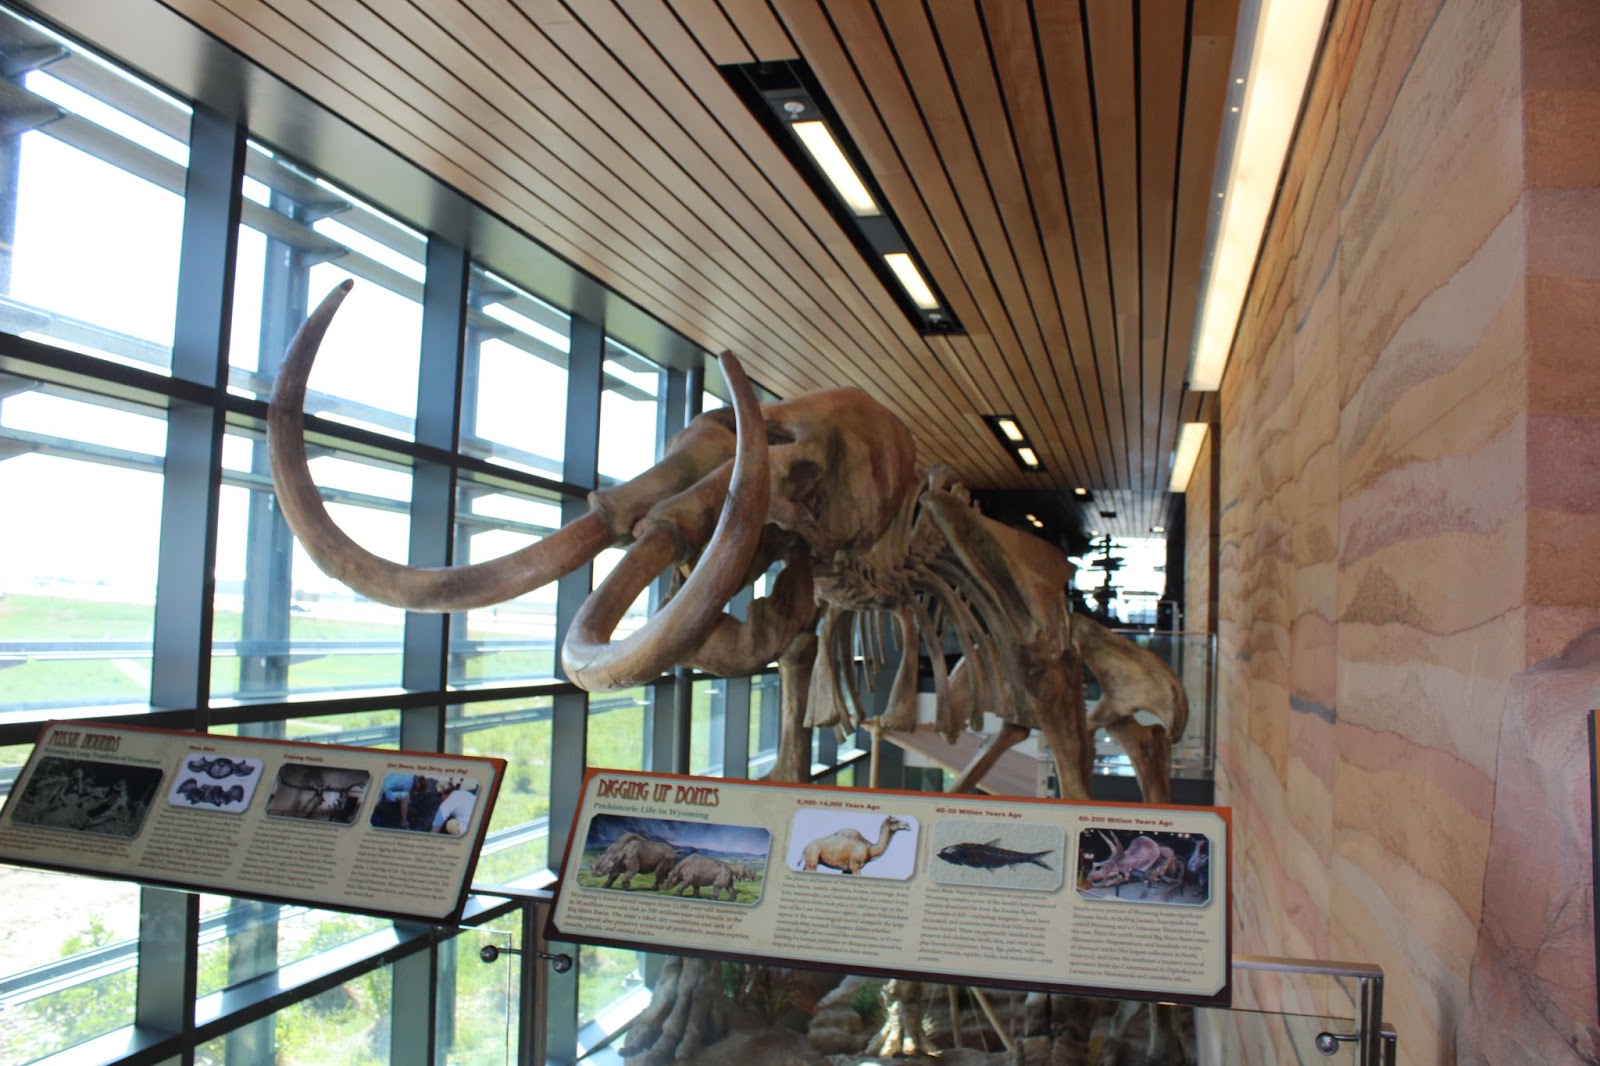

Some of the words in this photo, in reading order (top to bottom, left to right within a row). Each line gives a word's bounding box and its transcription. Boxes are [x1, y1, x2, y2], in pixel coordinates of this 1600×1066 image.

[596, 779, 649, 801] DIGGING
[653, 783, 673, 803] UP
[674, 785, 720, 807] BONES
[594, 802, 639, 813] Prehistoric
[641, 806, 657, 814] Life
[658, 807, 667, 815] in
[669, 809, 710, 820] Wyoming
[959, 808, 983, 816] Million
